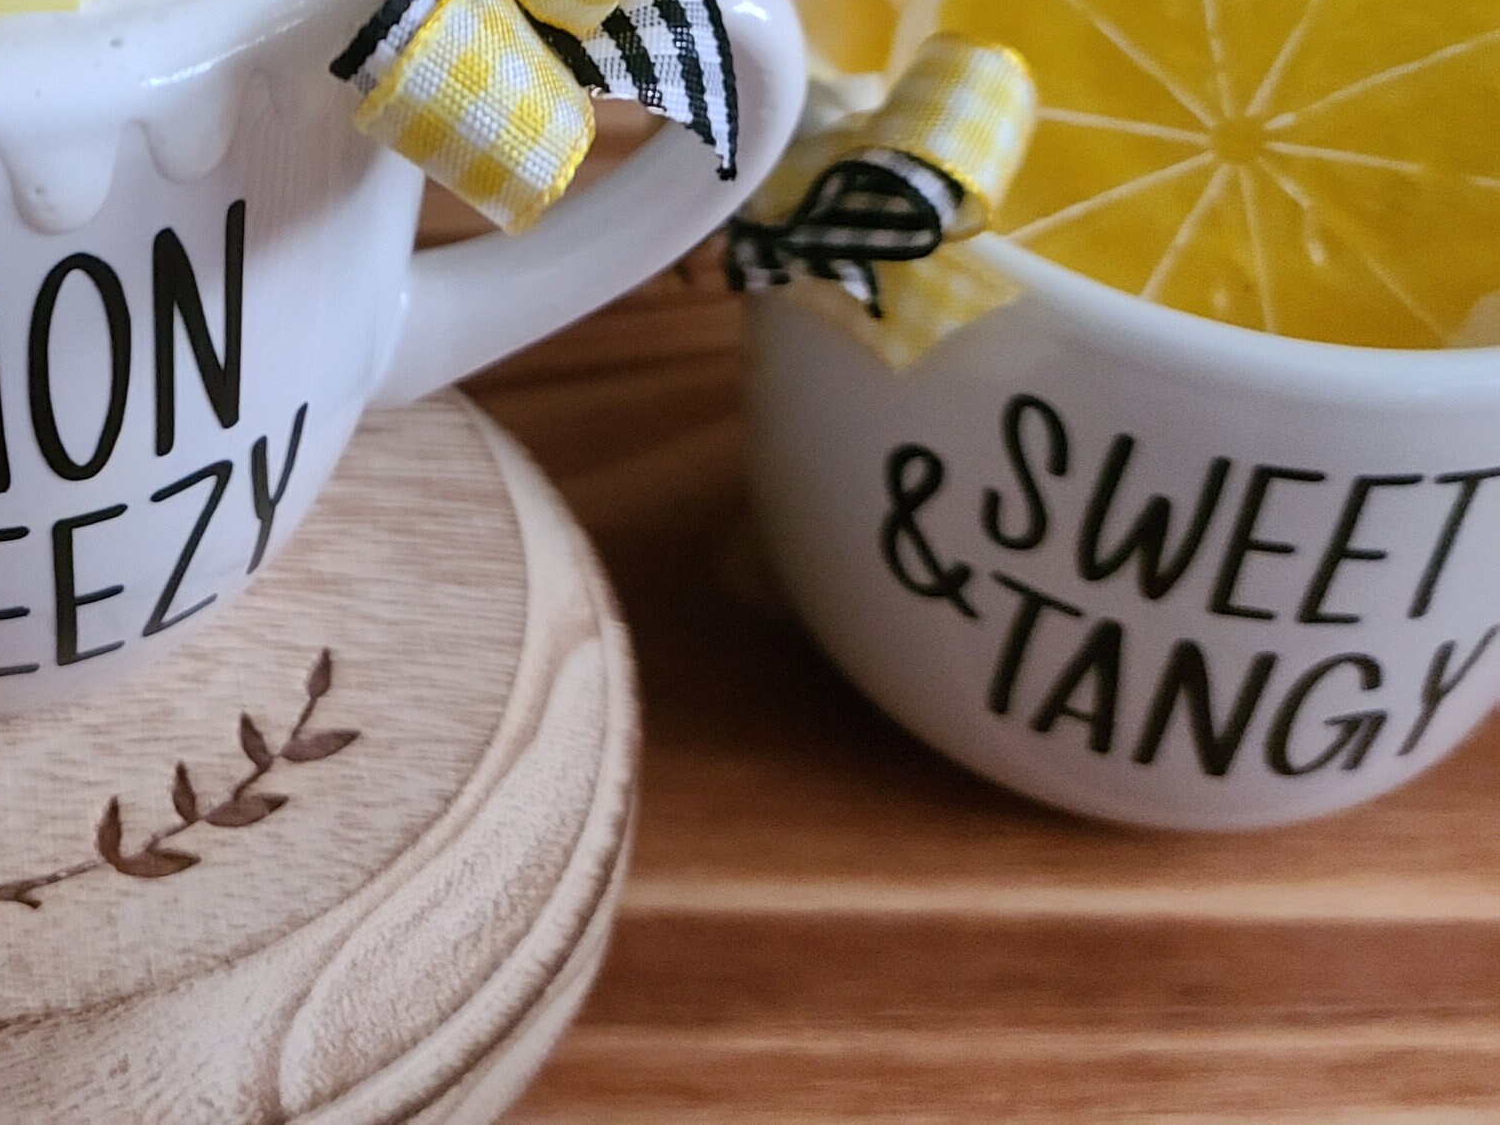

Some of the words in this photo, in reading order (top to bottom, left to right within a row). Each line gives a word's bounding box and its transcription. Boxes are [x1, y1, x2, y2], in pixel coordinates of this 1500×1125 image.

[880, 441, 980, 623] &
[984, 570, 1500, 777] TANGY
[980, 392, 1500, 626] SWEET
